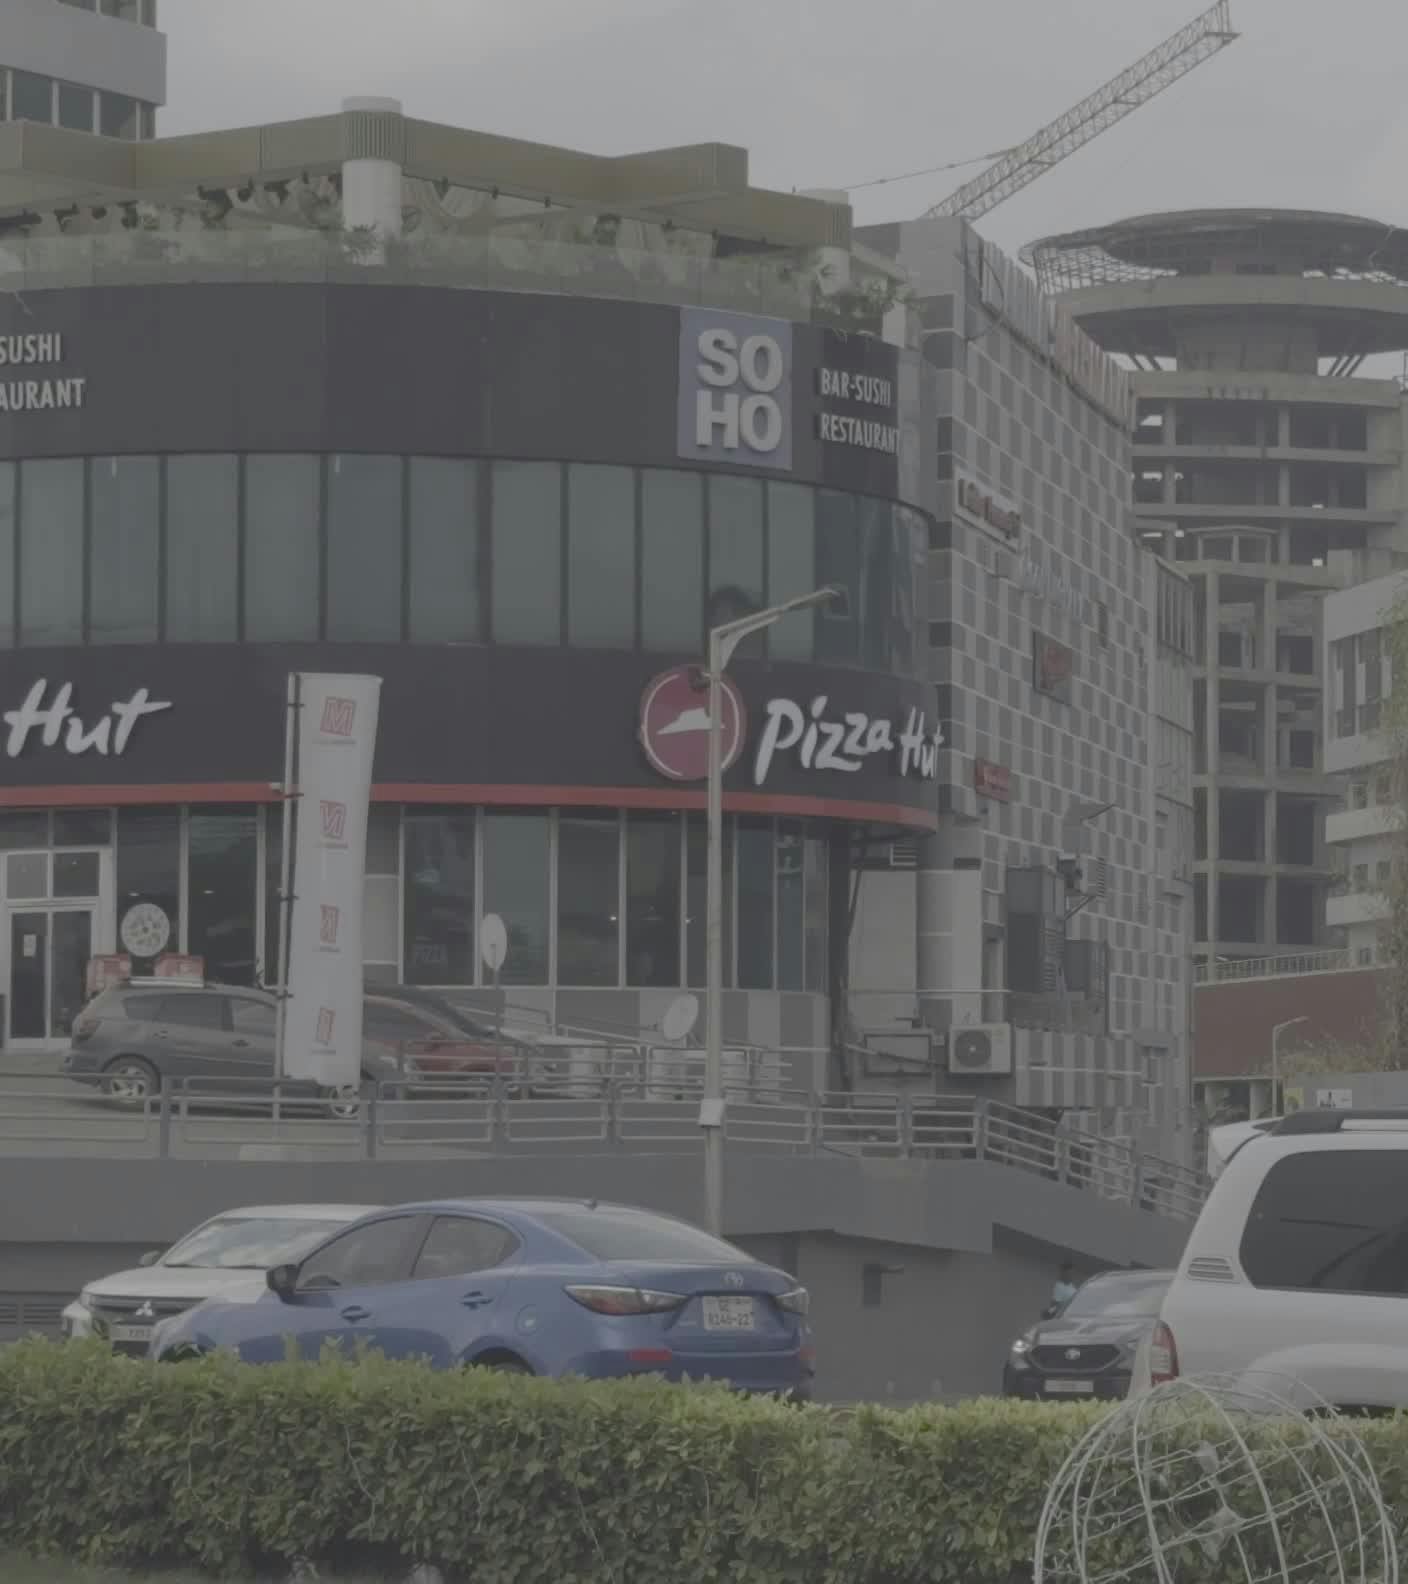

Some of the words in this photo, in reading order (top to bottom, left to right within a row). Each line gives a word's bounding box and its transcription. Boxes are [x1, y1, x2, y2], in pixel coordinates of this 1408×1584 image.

[696, 328, 783, 392] SO
[820, 368, 892, 407] BAR-SUSHI
[695, 390, 782, 451] HO
[820, 413, 902, 456] RESTAURANT
[3, 677, 173, 758] Hut
[754, 695, 894, 786] Pizza
[900, 705, 944, 778] Hut
